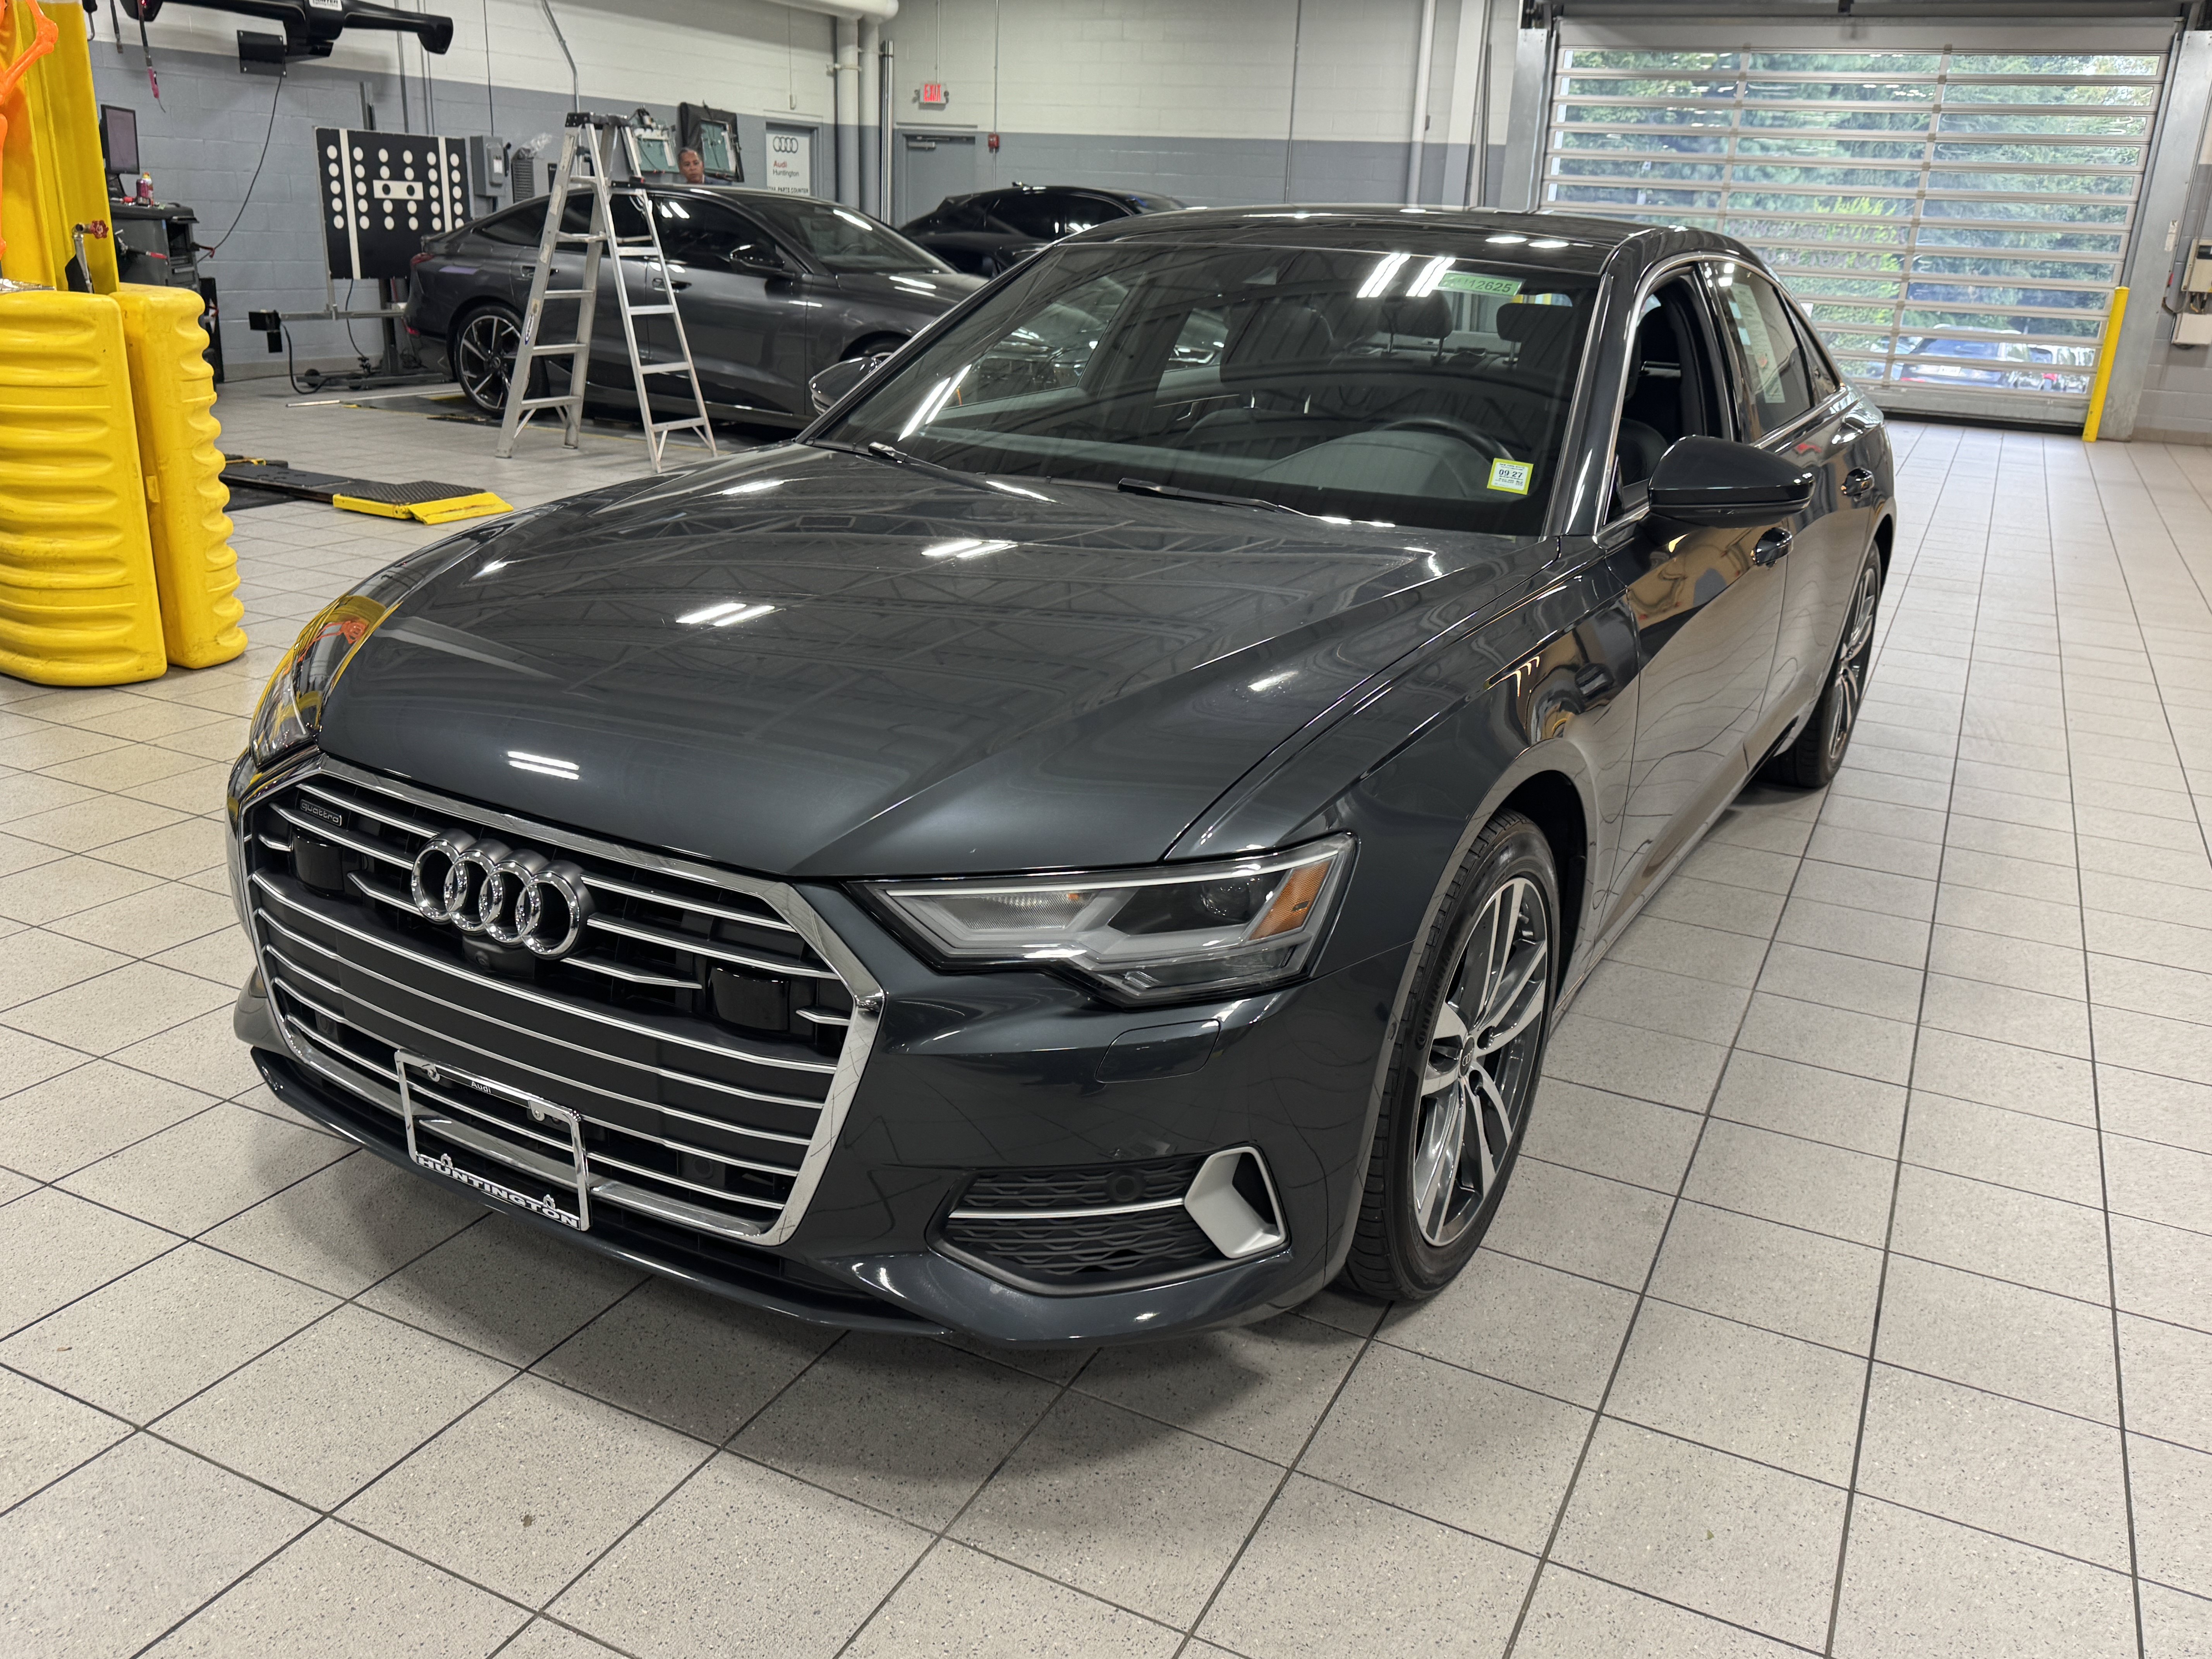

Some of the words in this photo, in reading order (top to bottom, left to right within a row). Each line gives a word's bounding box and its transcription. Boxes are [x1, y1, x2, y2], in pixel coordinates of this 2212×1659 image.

[924, 84, 941, 101] EXIT
[773, 169, 799, 178] Huntington
[302, 802, 339, 823] quattro
[471, 1081, 491, 1093] Audi
[418, 1157, 577, 1228] HUNTINGTON
